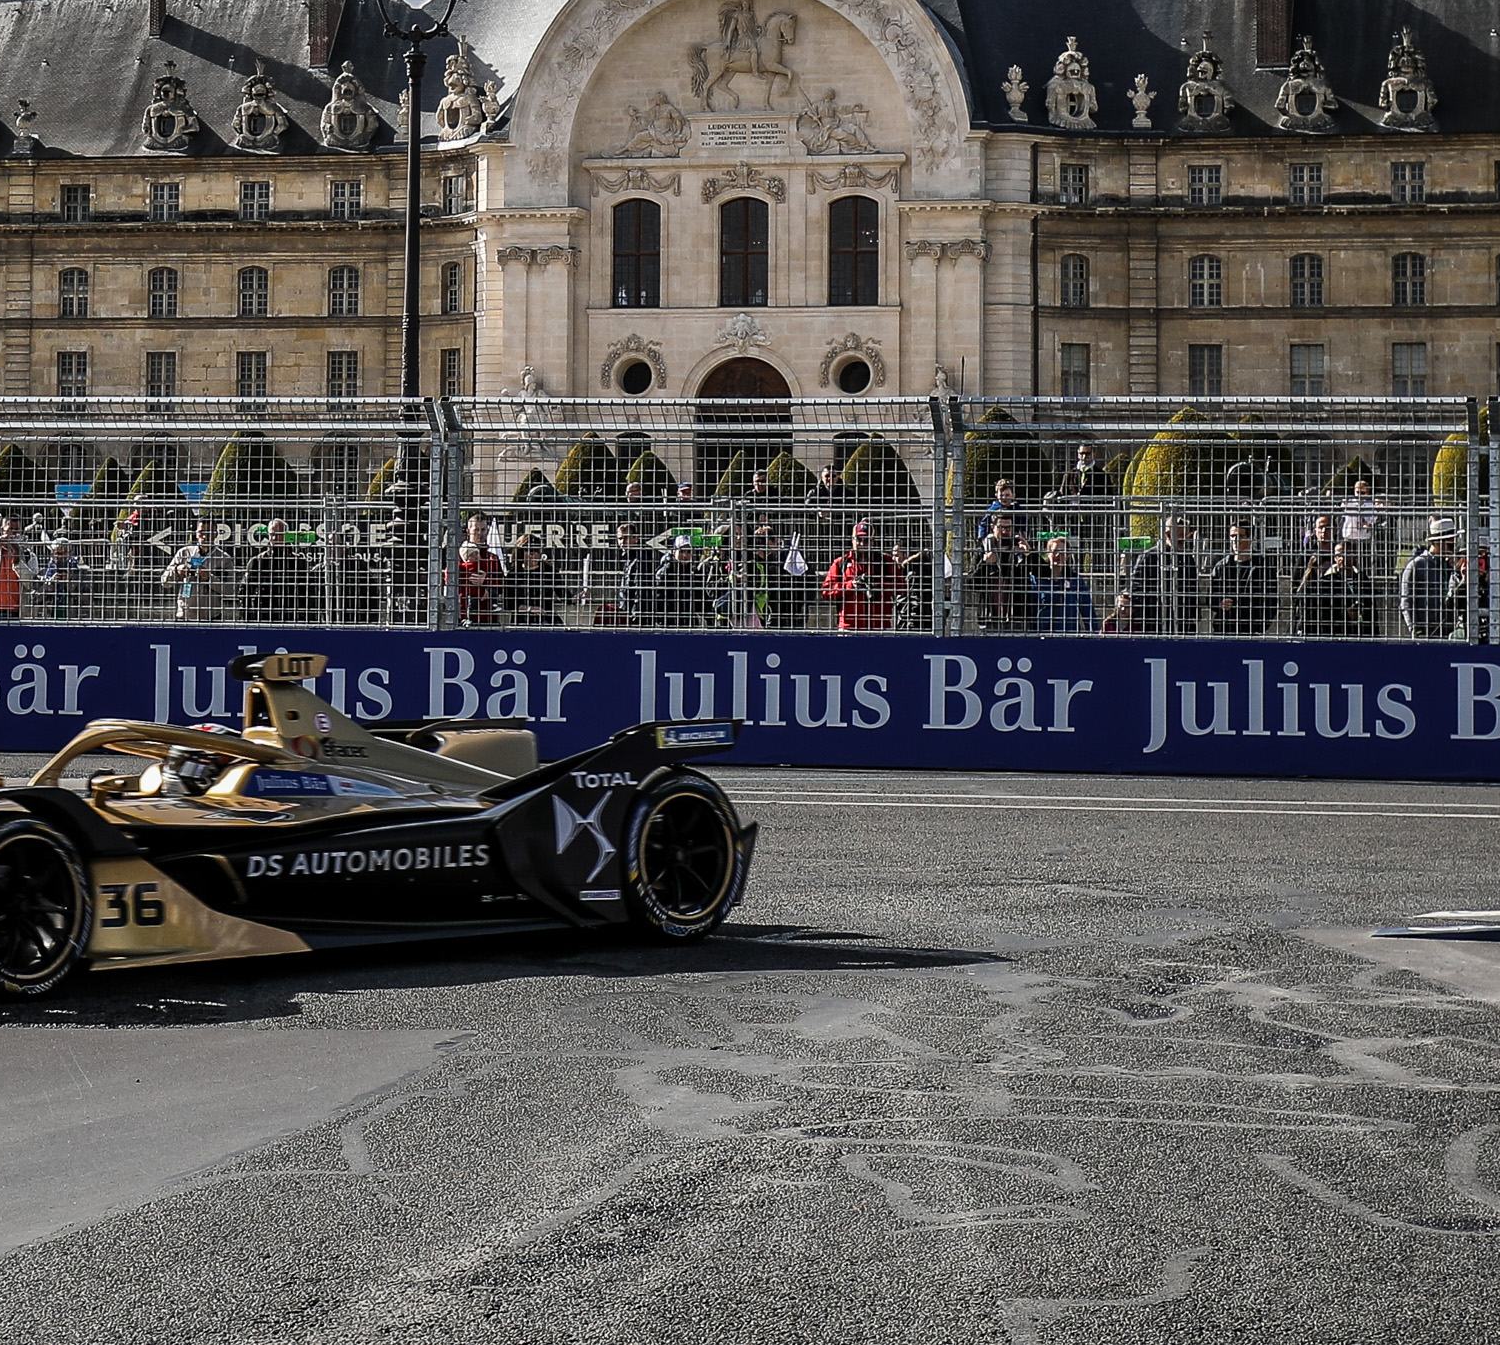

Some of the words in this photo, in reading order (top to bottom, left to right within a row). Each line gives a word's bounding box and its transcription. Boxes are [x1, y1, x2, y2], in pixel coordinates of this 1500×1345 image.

[422, 647, 585, 724] Bär
[635, 649, 891, 729] Julius
[922, 654, 1094, 733] Bär
[1143, 658, 1416, 753] Julius
[255, 775, 299, 792] Julius
[301, 776, 328, 791] Bär
[246, 855, 285, 877] DS
[289, 844, 491, 875] AUTOMOBILES
[100, 882, 167, 928] 36
